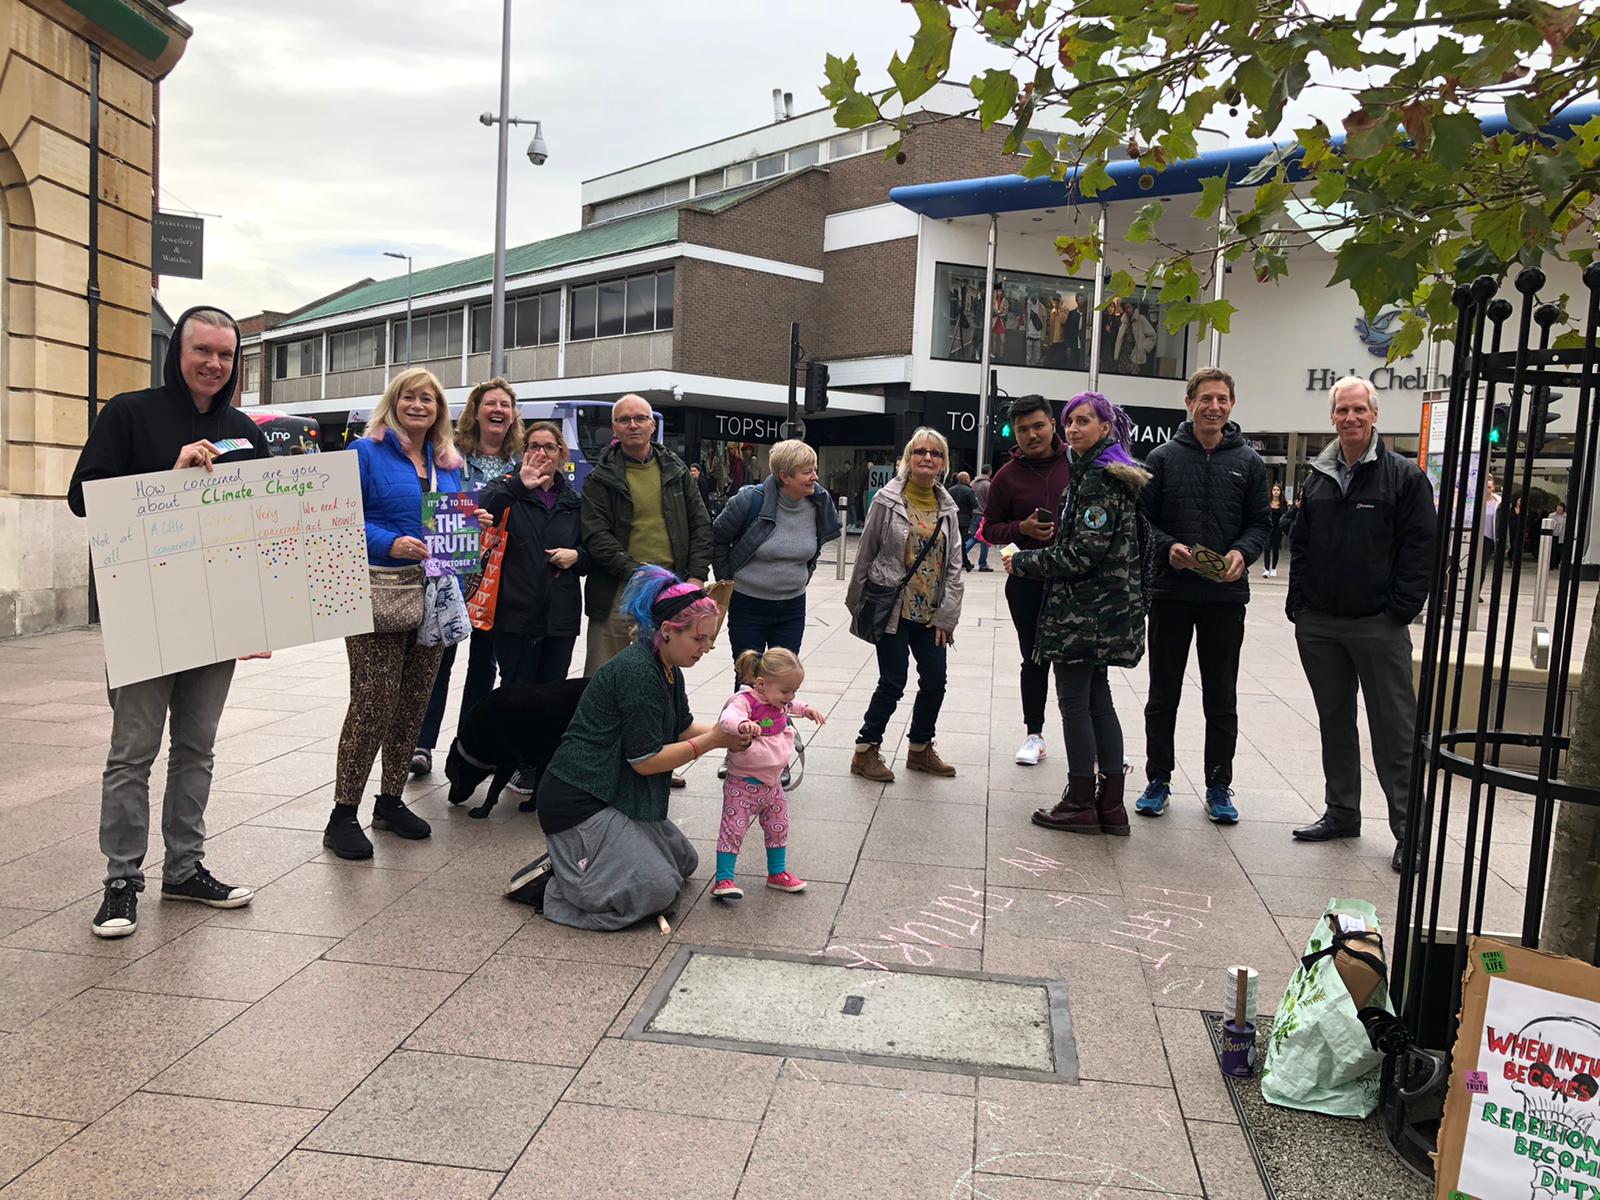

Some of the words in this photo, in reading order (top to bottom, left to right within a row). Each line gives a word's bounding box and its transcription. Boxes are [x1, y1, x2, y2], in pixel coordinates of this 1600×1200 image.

[161, 235, 193, 247] Jewellery
[162, 254, 192, 264] Watches
[135, 480, 166, 497] How
[183, 468, 243, 491] concerned
[262, 468, 282, 480] are
[292, 463, 318, 482] you
[137, 498, 180, 515] about
[255, 504, 279, 522] Very
[303, 501, 316, 514] We
[321, 498, 338, 513] need
[345, 497, 357, 508] to
[427, 500, 439, 508] IT'S
[258, 521, 301, 538] concerned
[305, 519, 322, 531] act
[435, 513, 466, 533] THE
[92, 532, 110, 546] Not
[120, 527, 133, 543] at
[153, 535, 197, 554] concerned
[424, 533, 479, 554] TRUTH
[104, 547, 120, 565] all
[441, 559, 471, 568] OCTOBER
[1485, 961, 1504, 971] LIFE
[1486, 1026, 1553, 1066] WHEN
[1466, 1082, 1488, 1091] TRUTH
[1503, 1060, 1592, 1102] BECOMES
[1481, 1102, 1600, 1157] REBELLION
[1514, 1136, 1600, 1178] BECOM
